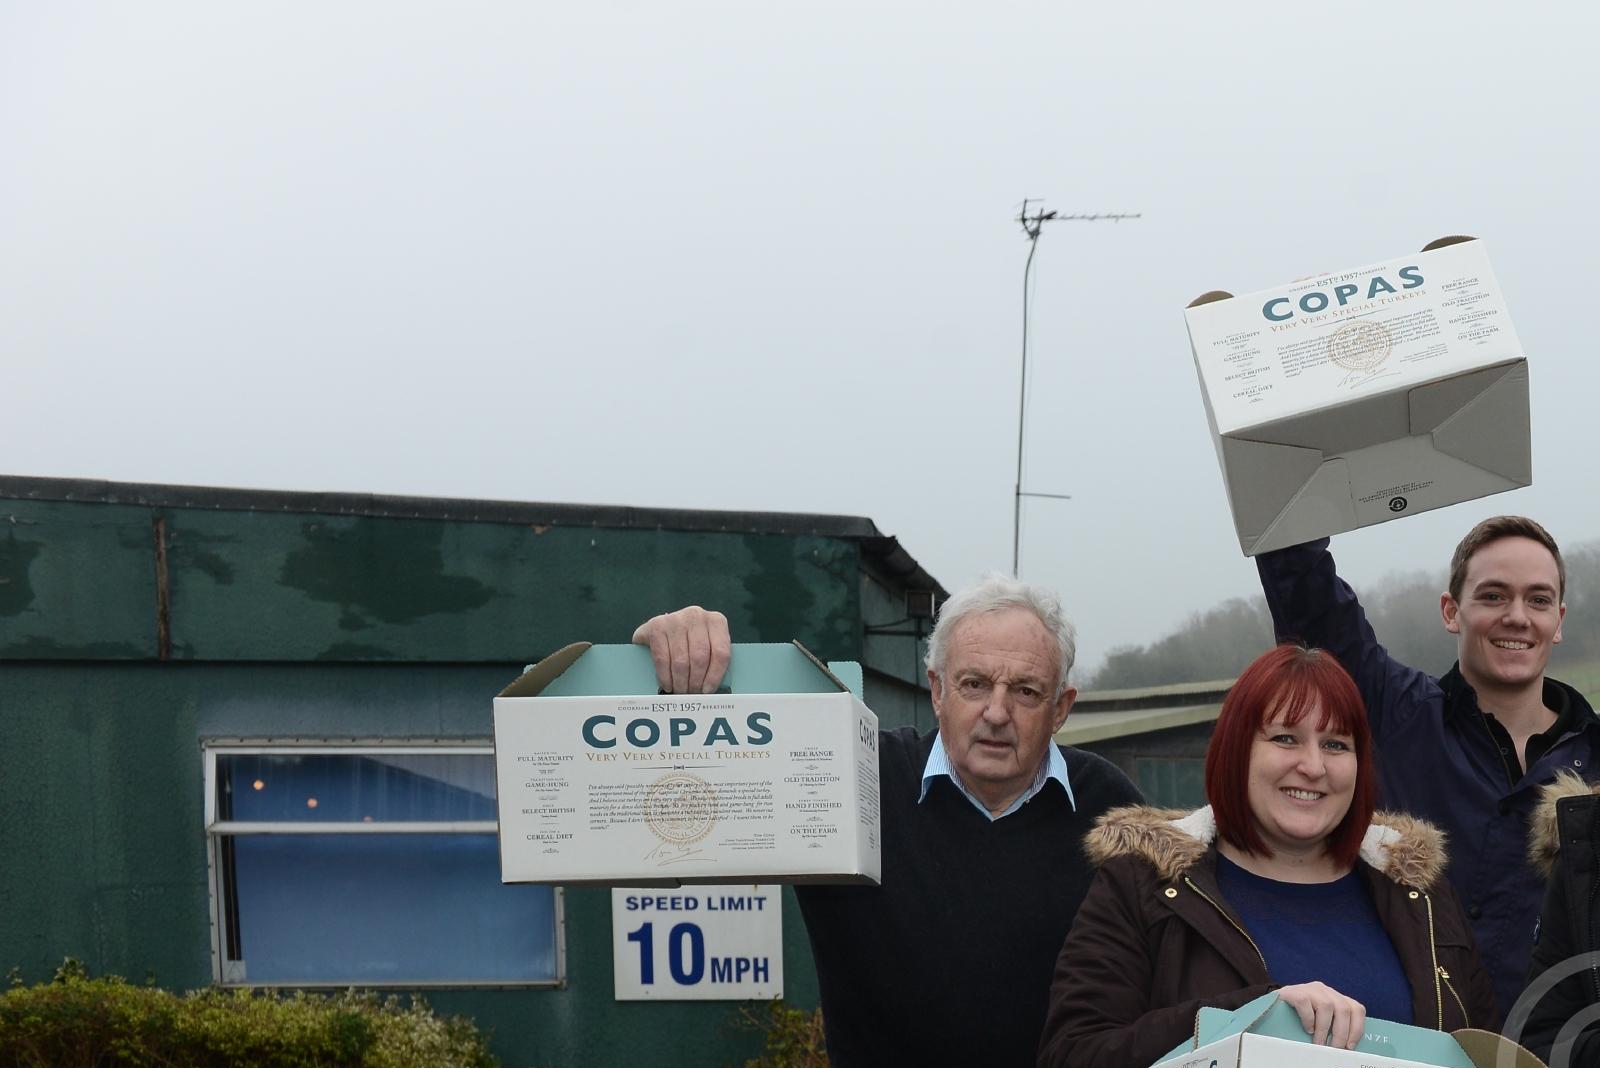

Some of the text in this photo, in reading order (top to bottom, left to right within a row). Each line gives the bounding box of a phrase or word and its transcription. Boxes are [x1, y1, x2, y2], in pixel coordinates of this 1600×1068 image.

[1262, 265, 1424, 322] COPAS
[680, 703, 702, 712] 1957
[582, 712, 773, 749] COPAS
[626, 896, 766, 911] SPEED LIMIT
[627, 922, 769, 986] 10 MPH
